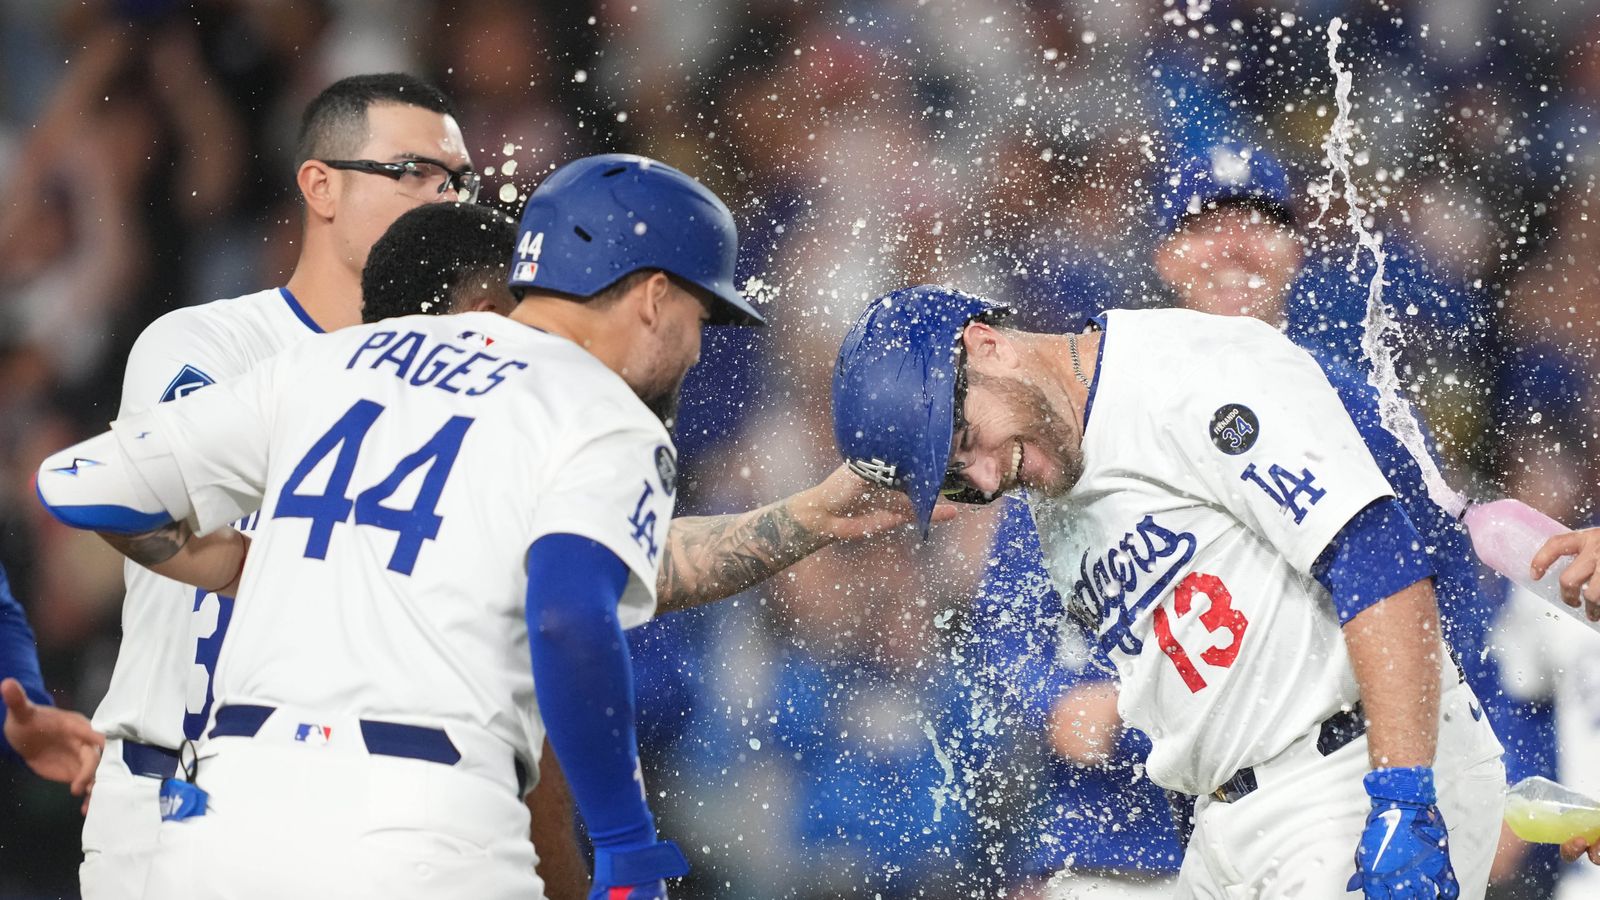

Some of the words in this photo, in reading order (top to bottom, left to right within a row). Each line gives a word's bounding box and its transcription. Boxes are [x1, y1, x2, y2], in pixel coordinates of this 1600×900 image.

[517, 230, 544, 262] 44
[345, 330, 528, 396] PAGES
[1213, 408, 1239, 435] FERNANDO
[1222, 415, 1254, 448] 34
[271, 398, 476, 577] 44
[845, 458, 896, 486] LA
[1240, 462, 1327, 526] LA
[627, 478, 658, 568] LA
[1153, 571, 1249, 694] 13
